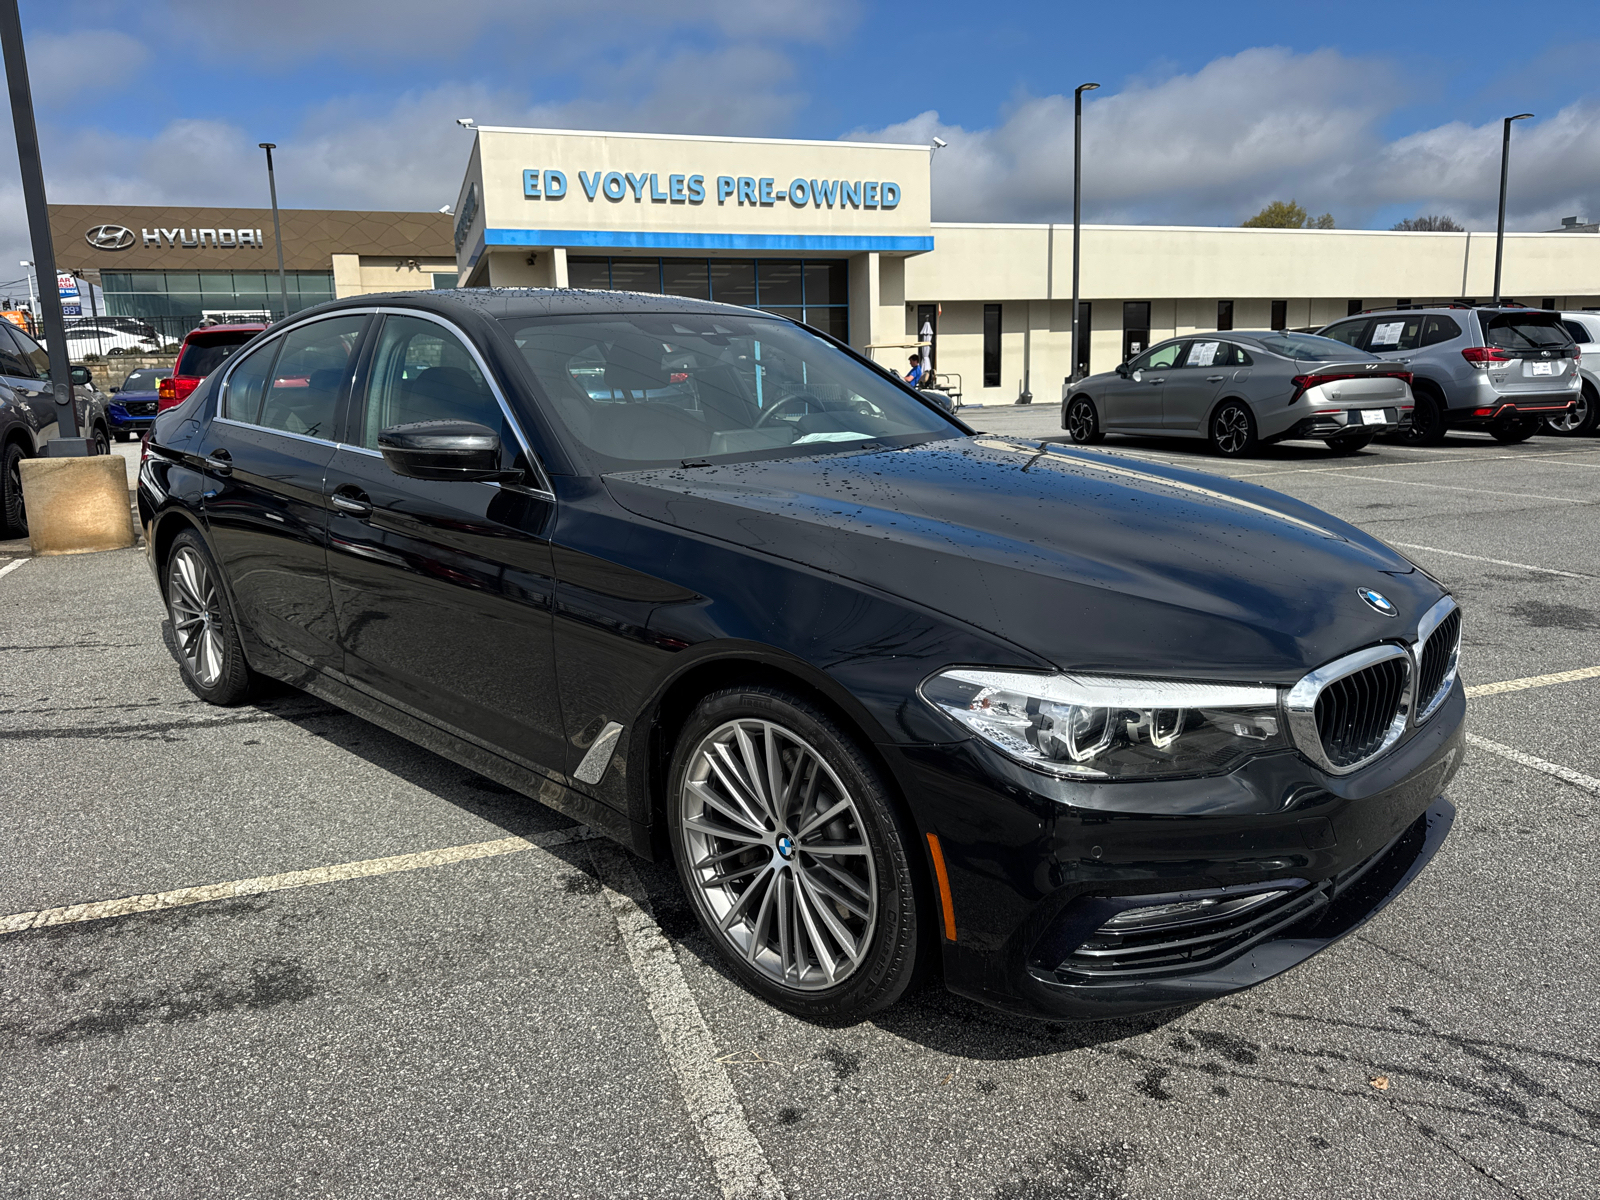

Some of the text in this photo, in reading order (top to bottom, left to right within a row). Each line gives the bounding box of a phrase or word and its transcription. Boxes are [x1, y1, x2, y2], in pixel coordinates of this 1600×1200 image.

[523, 169, 902, 210] ED VOYLES PRE-OWNED
[141, 228, 264, 247] HYUNDAI
[739, 695, 772, 710] PIRELLI
[873, 909, 897, 977] Cinturato
